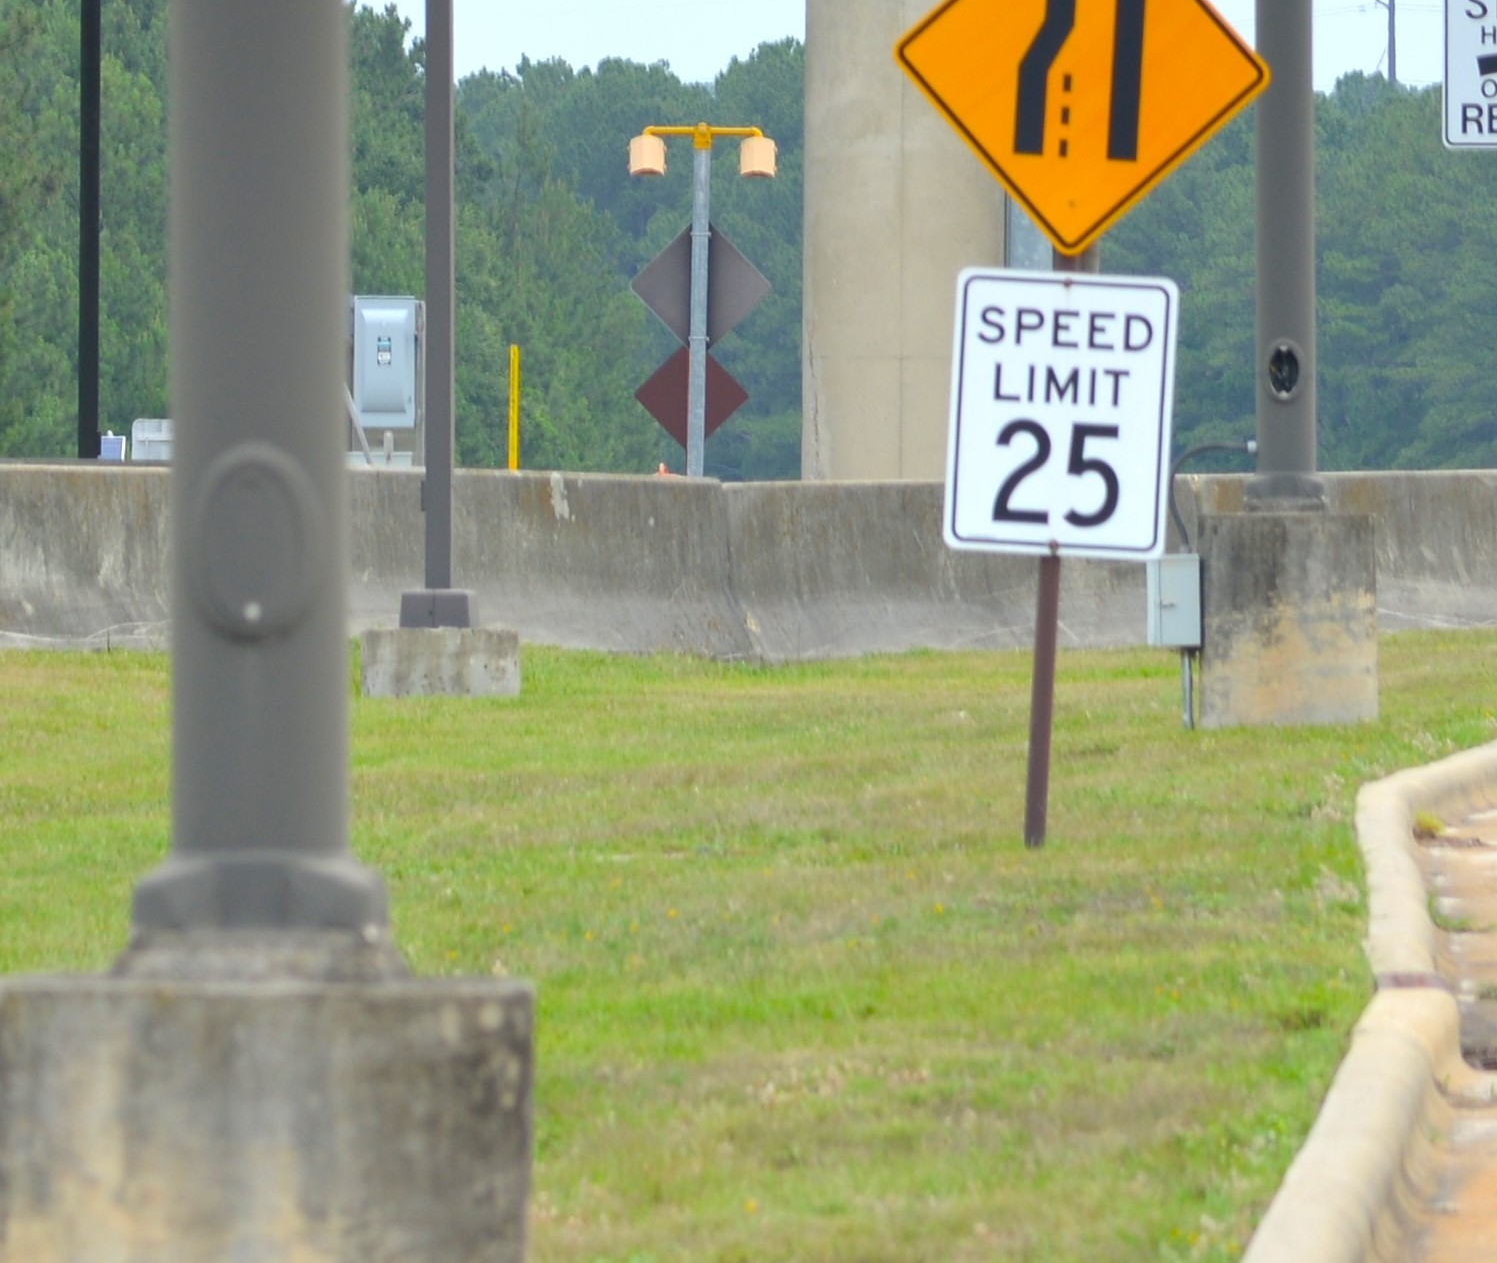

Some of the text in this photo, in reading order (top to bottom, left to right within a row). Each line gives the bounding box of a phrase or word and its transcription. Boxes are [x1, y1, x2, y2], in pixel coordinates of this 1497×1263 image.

[978, 305, 1154, 352] SPEED
[993, 362, 1130, 408] LIMIT
[992, 418, 1120, 528] 25
